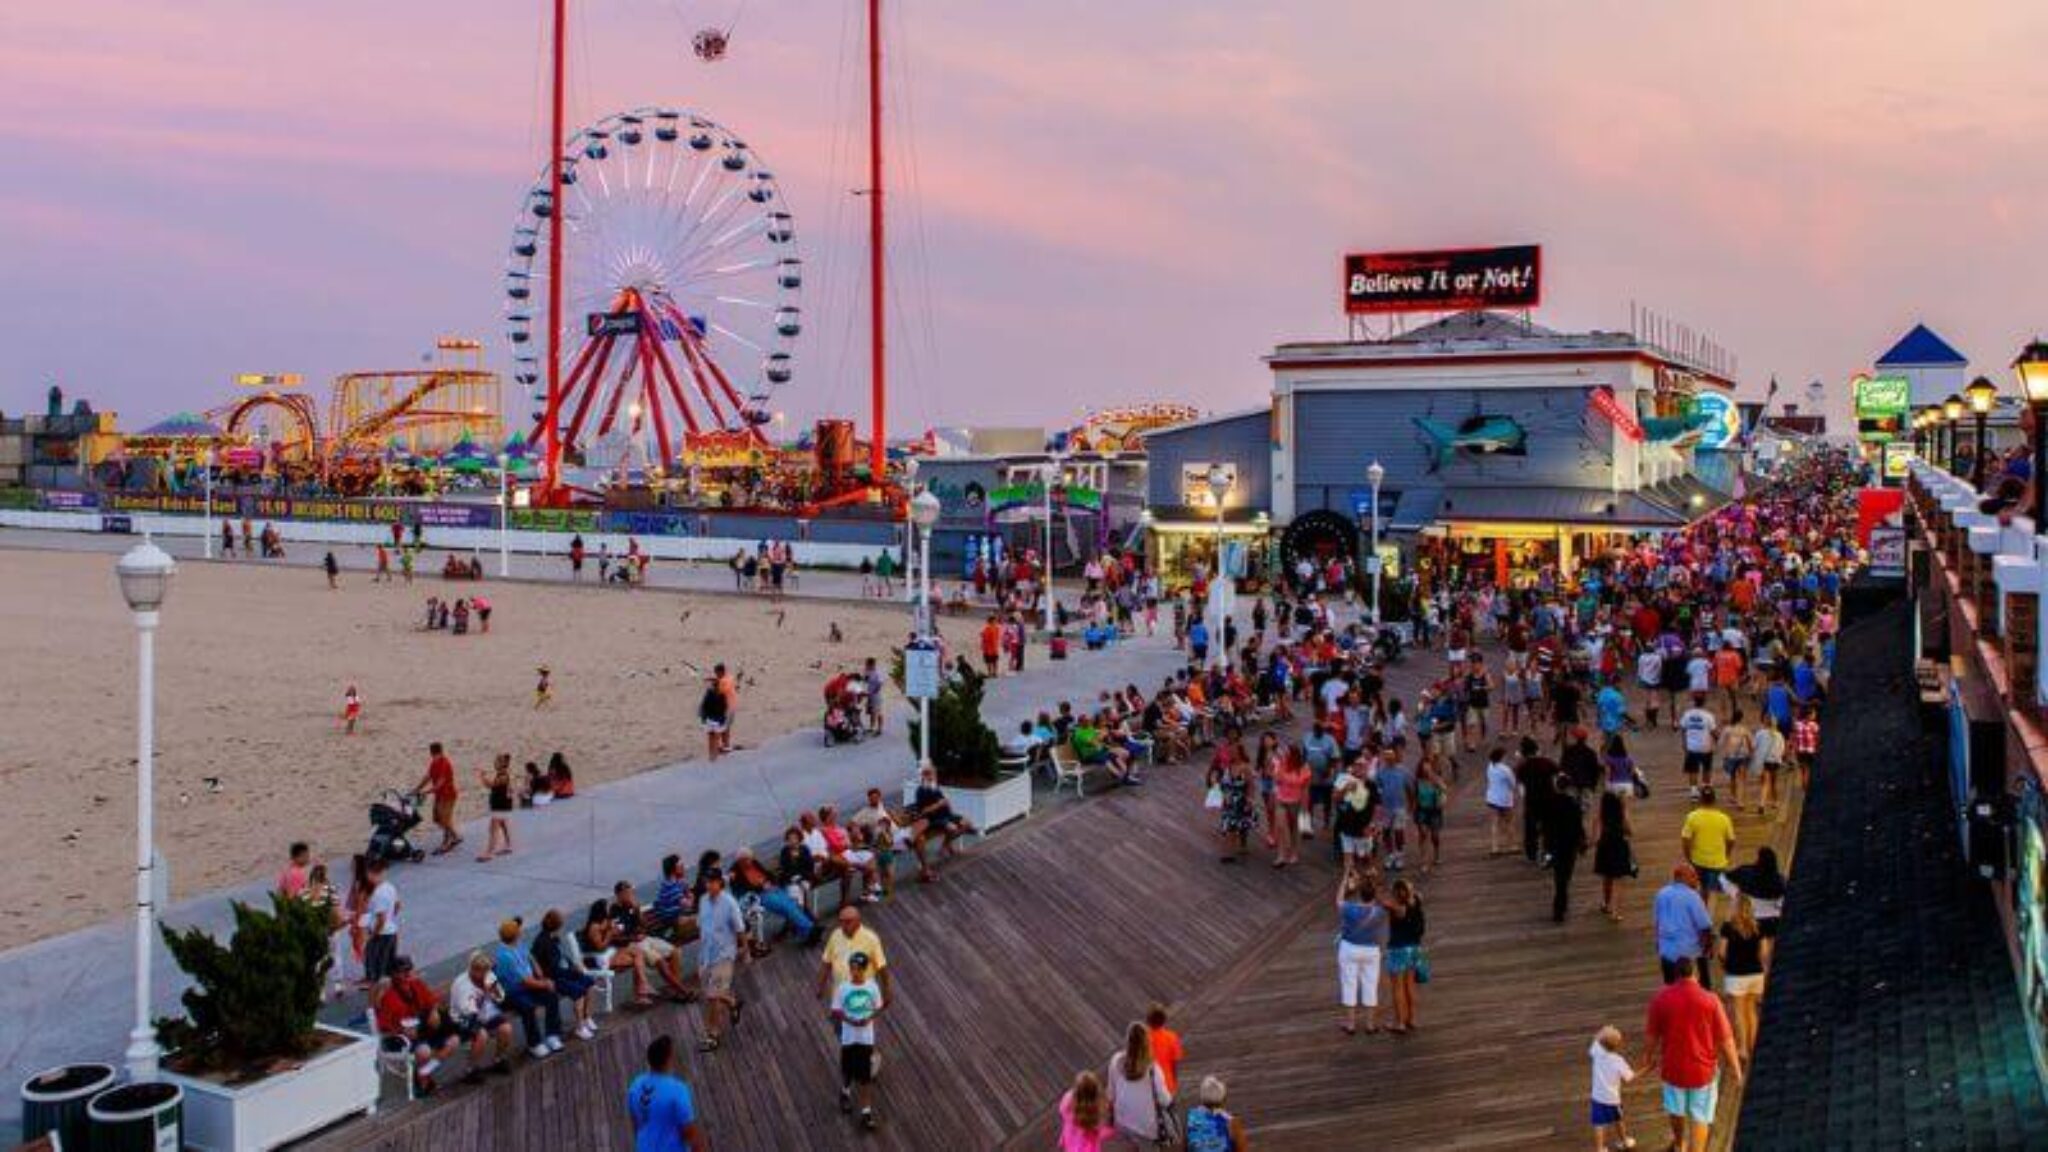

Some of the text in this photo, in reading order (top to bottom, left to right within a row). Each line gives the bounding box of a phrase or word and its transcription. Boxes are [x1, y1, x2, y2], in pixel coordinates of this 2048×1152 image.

[1350, 266, 1532, 295] Believe It or Not!
